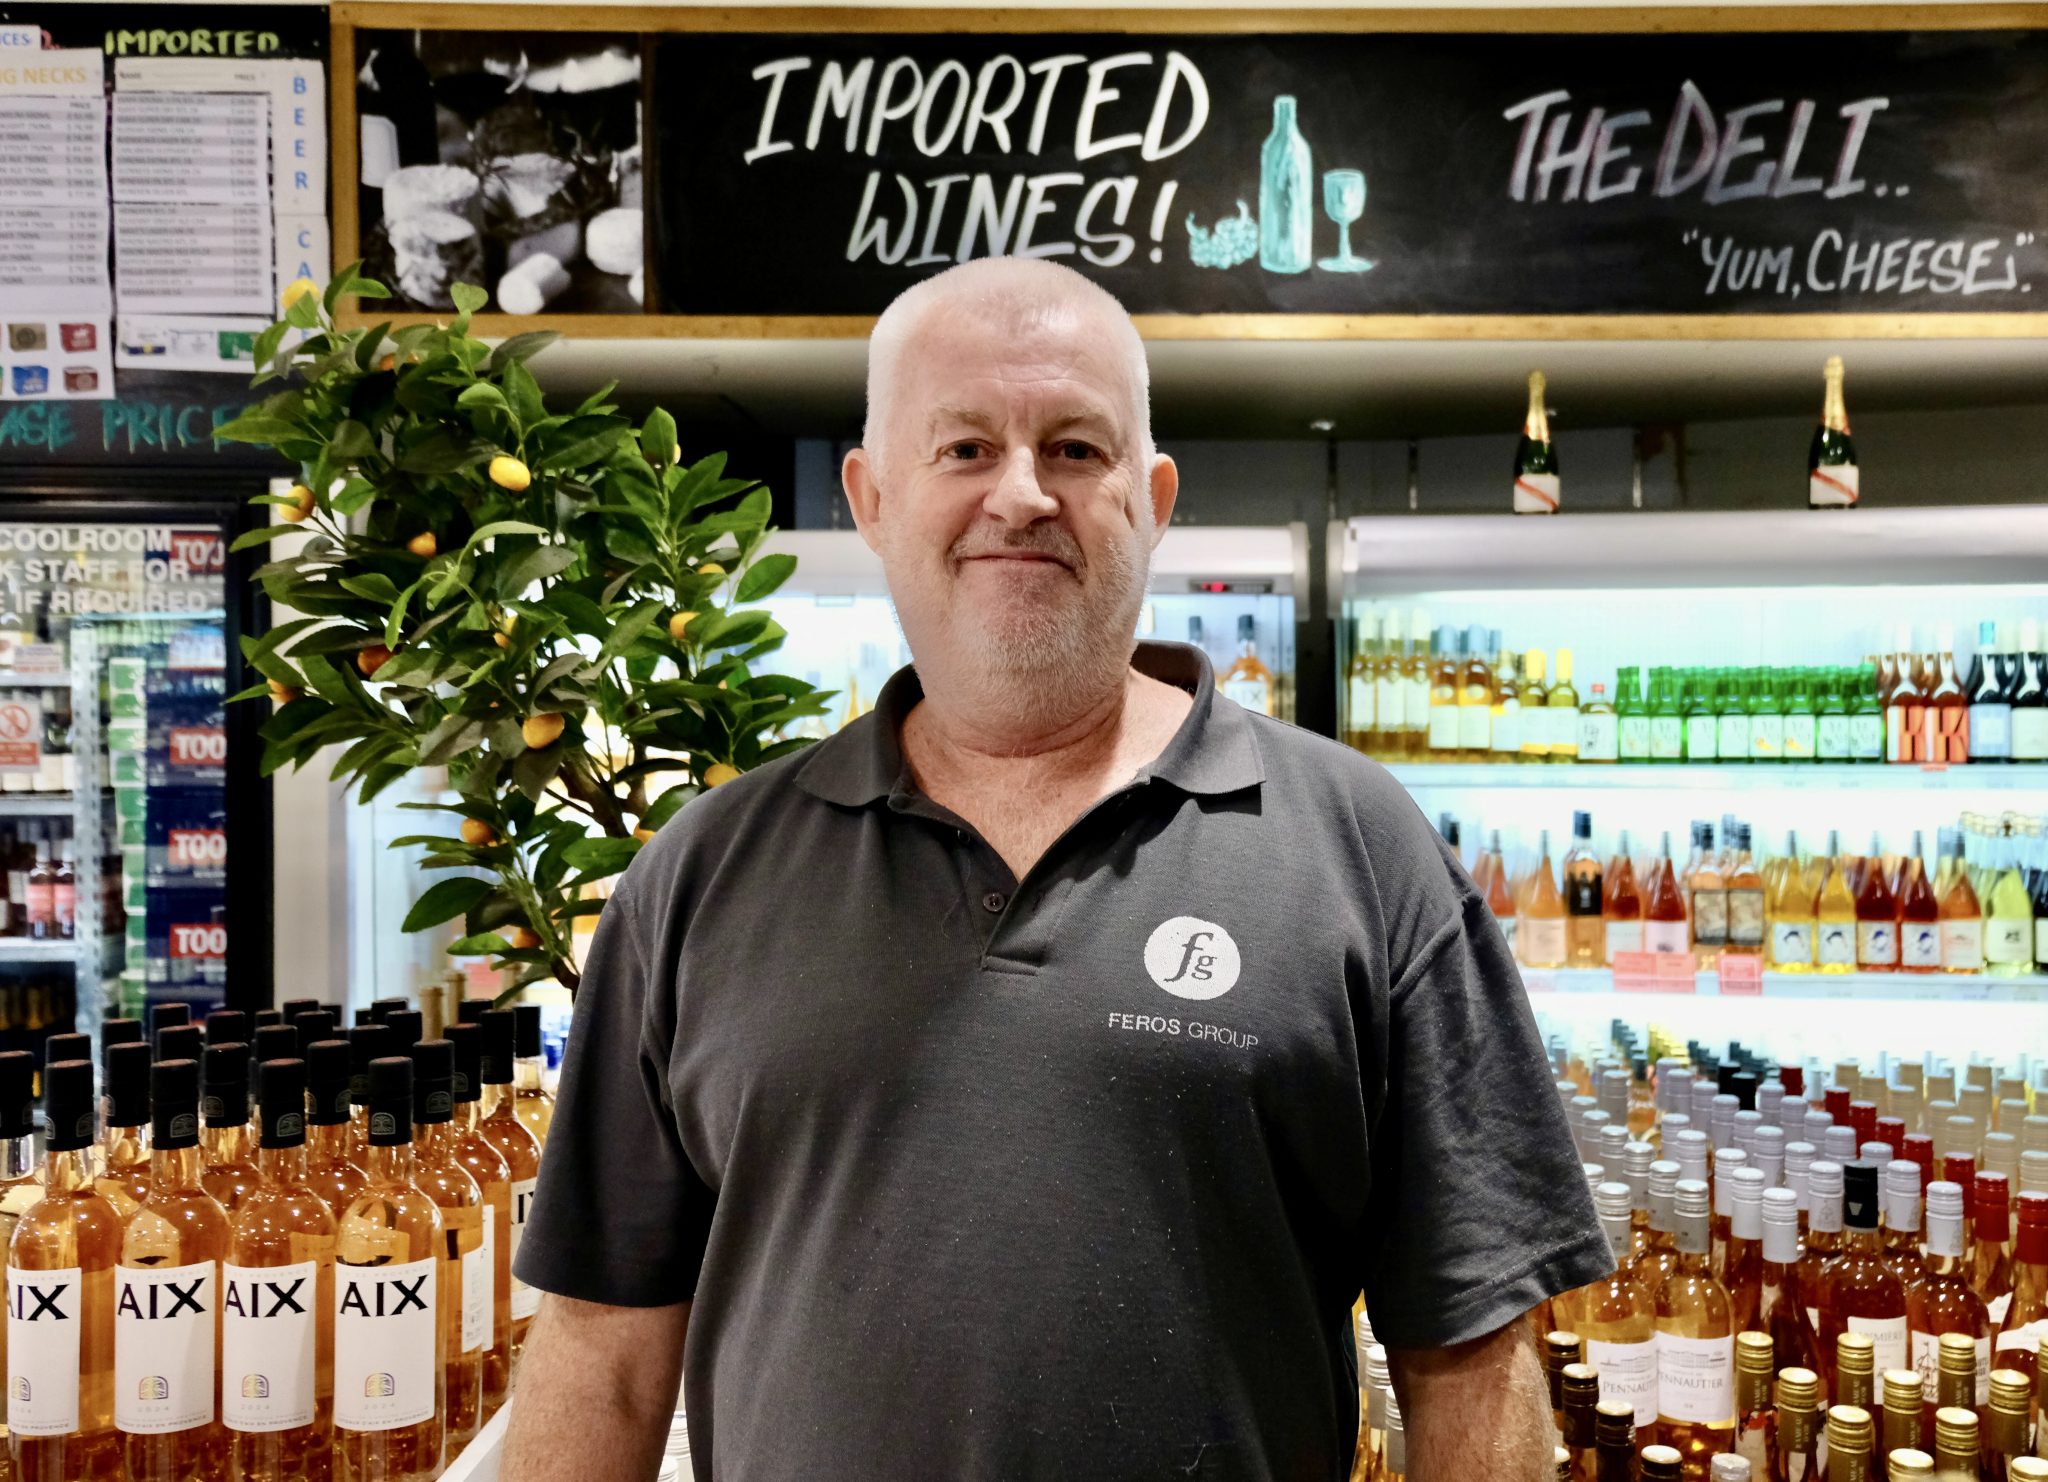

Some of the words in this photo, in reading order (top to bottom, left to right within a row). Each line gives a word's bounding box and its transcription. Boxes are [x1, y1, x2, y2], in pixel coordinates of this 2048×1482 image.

[105, 29, 280, 55] IMPORTED
[24, 66, 87, 84] NECKS
[744, 51, 1209, 166] IMPORTED
[1503, 89, 1652, 203] THE
[845, 171, 1179, 267] WINES!
[0, 528, 172, 552] COOLROOM
[25, 559, 121, 583] STAFF
[127, 559, 189, 583] FOR
[15, 591, 44, 614] IF
[50, 591, 208, 614] REQUIRED
[174, 833, 226, 860] TOO
[175, 927, 226, 954] TOO
[1108, 1012, 1181, 1035] FEROS
[1188, 1021, 1259, 1051] GROUP
[8, 1283, 71, 1322] IX
[117, 1276, 208, 1321] AIX
[224, 1277, 308, 1319] AIX
[339, 1274, 429, 1318] AIX
[1659, 1372, 1724, 1390] ENNAUTIER
